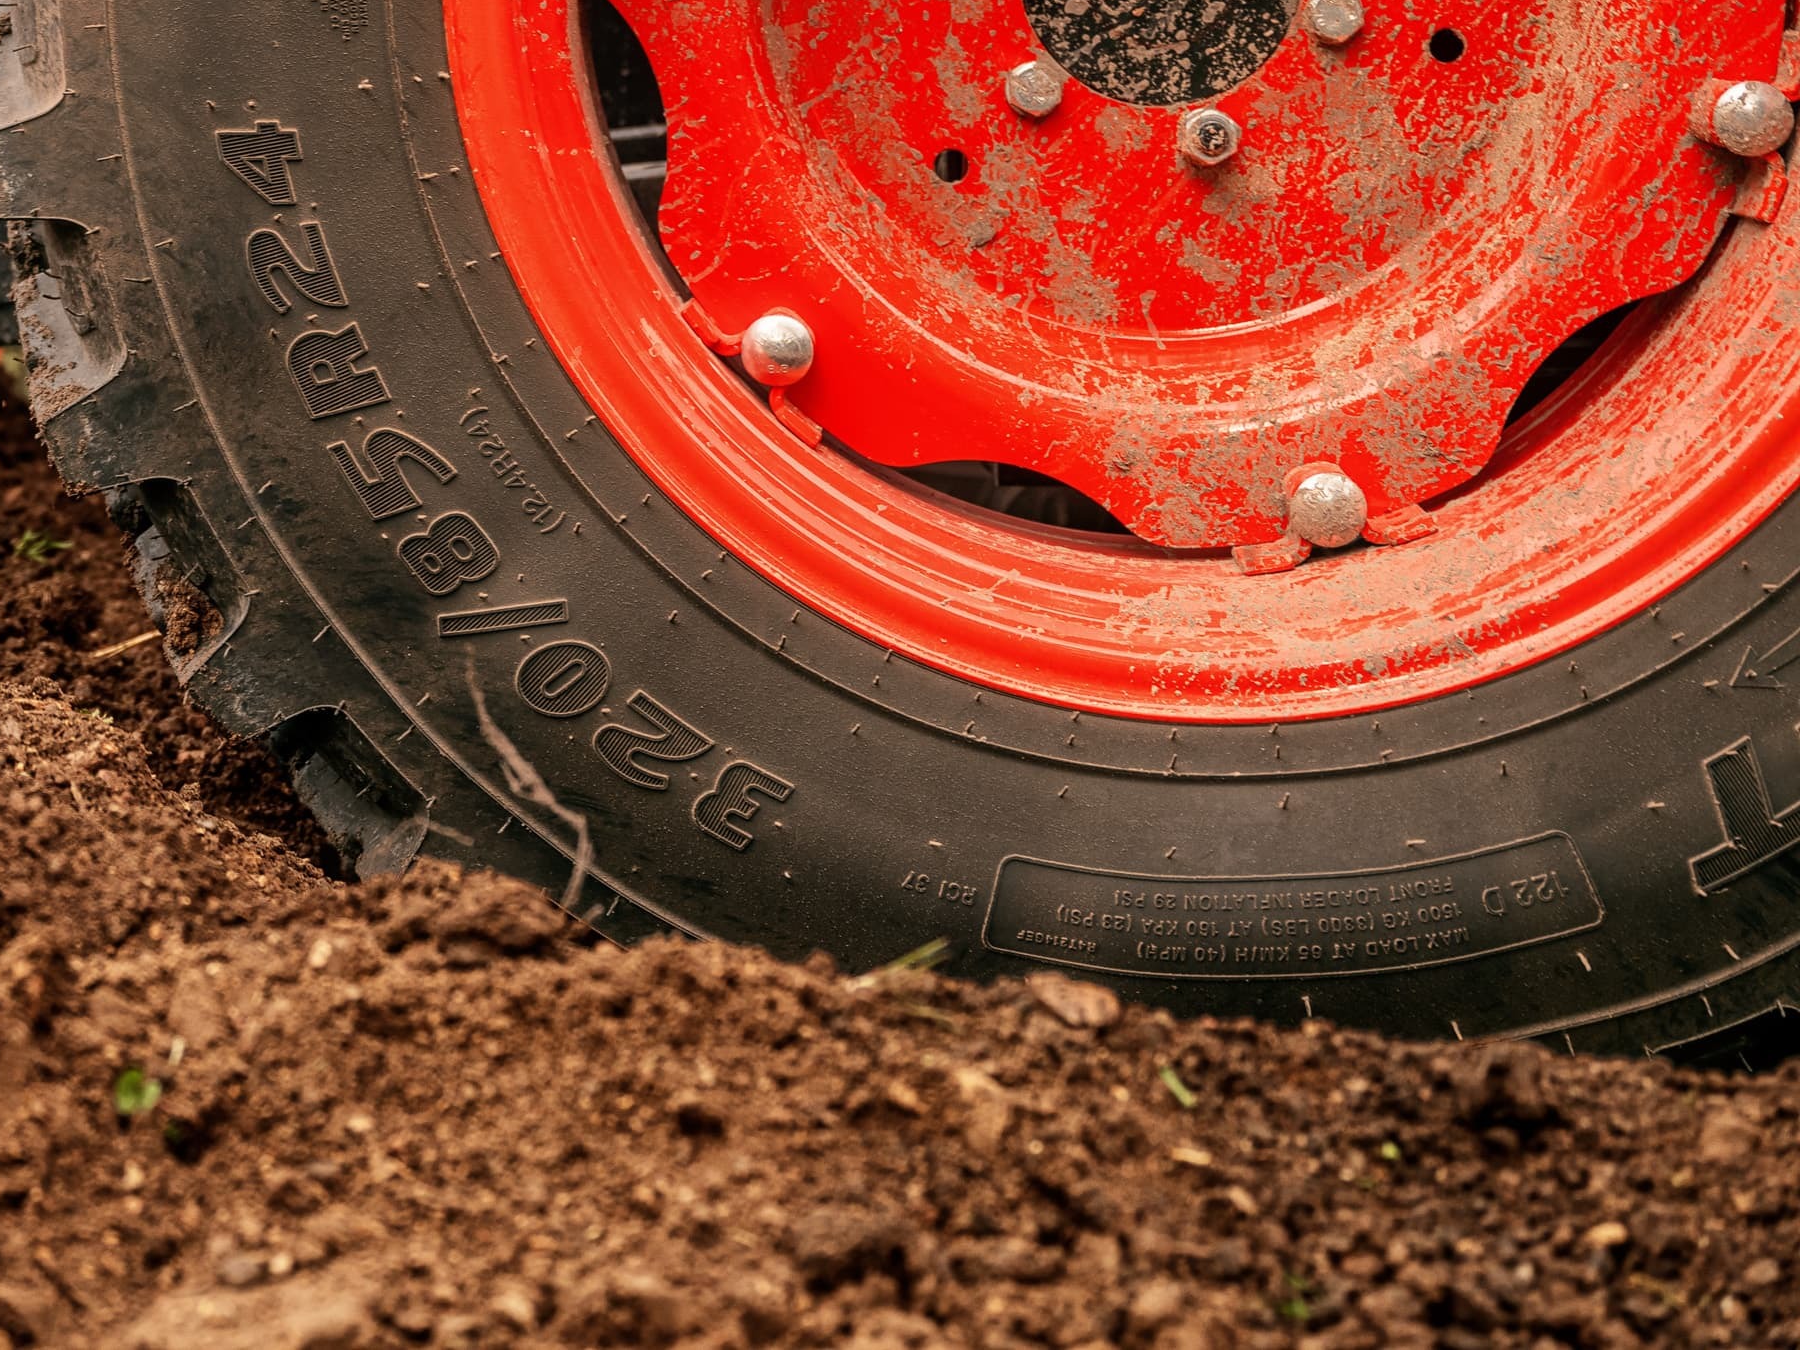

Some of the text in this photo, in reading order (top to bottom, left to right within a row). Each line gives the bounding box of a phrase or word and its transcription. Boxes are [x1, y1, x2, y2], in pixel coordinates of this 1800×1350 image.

[458, 406, 567, 534] (12.4R24)
[215, 119, 796, 851] 320/85R24
[1113, 888, 1147, 908] PSI
[1300, 887, 1381, 910] LOADER
[1389, 876, 1455, 903] FRONT
[1481, 870, 1570, 916] 122 D
[1184, 891, 1293, 912] INFLATION
[1056, 904, 1096, 927] PSI)
[1382, 909, 1412, 929] KG
[1417, 902, 1463, 923] 1500
[1142, 917, 1178, 935] KPA
[1228, 920, 1253, 937] AT
[1261, 917, 1310, 937] LBS)
[1366, 934, 1420, 956] LOAD
[1425, 927, 1471, 949] MAX
[1194, 946, 1227, 962] (40
[1235, 945, 1290, 962] KM/H
[1332, 943, 1356, 960] AT
